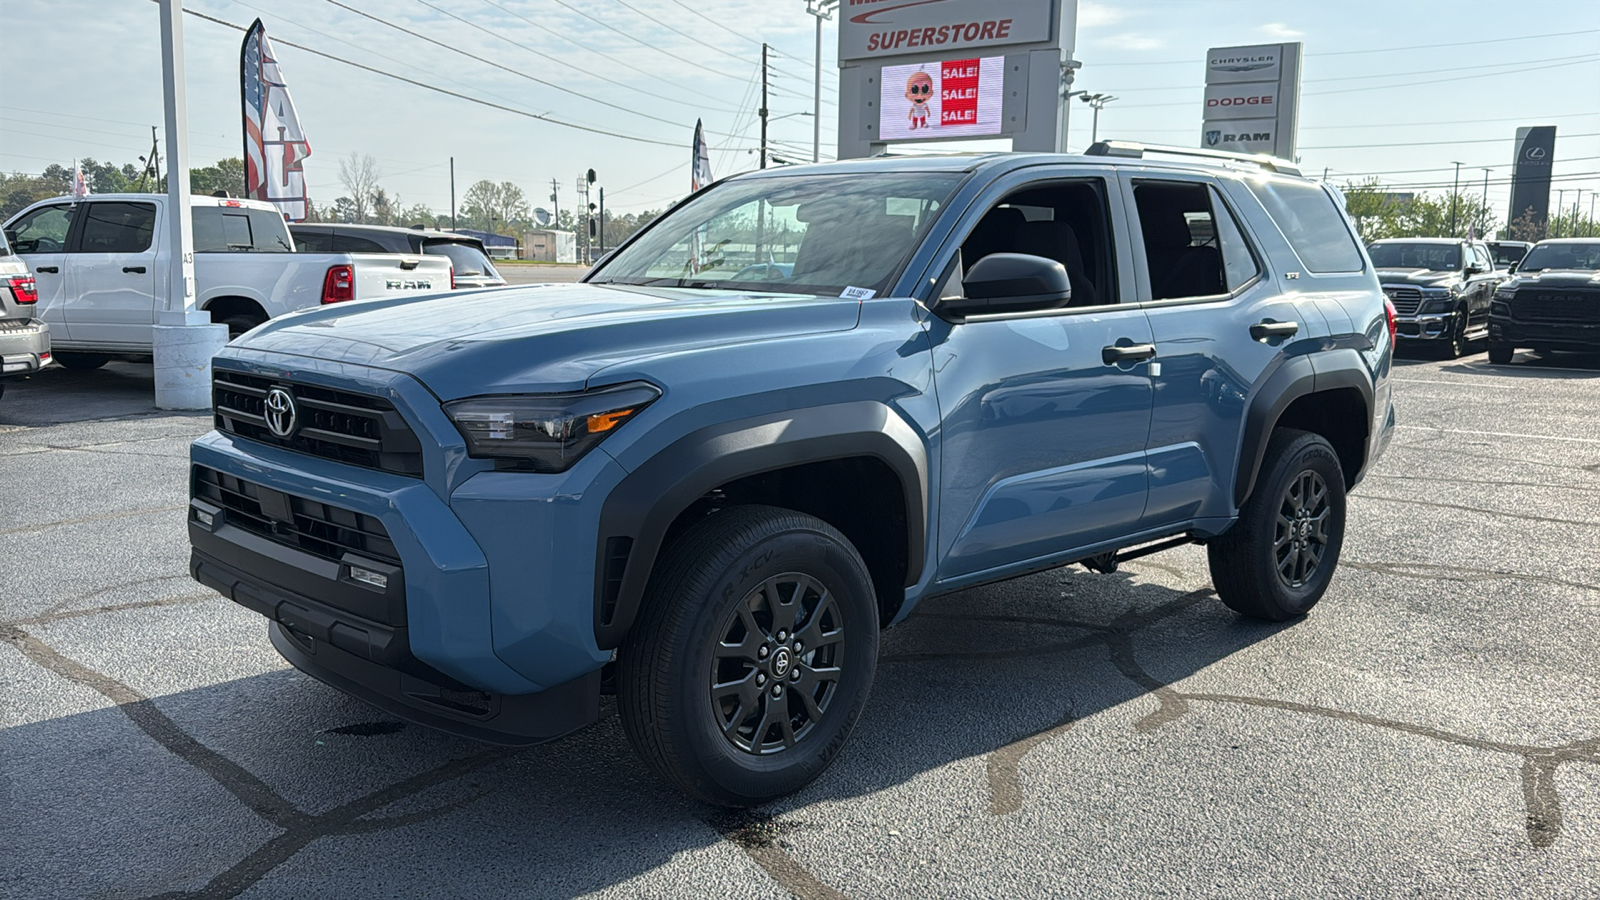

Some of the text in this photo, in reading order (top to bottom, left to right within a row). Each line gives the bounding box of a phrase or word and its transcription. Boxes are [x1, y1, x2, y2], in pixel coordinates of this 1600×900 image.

[867, 19, 1013, 51] SUPERSTORE
[1211, 56, 1274, 65] CHRYSLER
[943, 66, 978, 79] SALE!
[942, 87, 977, 100] SALE!
[1207, 96, 1273, 107] DODGE
[942, 109, 976, 121] SALE!
[1223, 133, 1270, 142] RAM
[183, 253, 193, 264] A3
[386, 279, 431, 290] RAM
[818, 686, 865, 762] OKOHAMA
